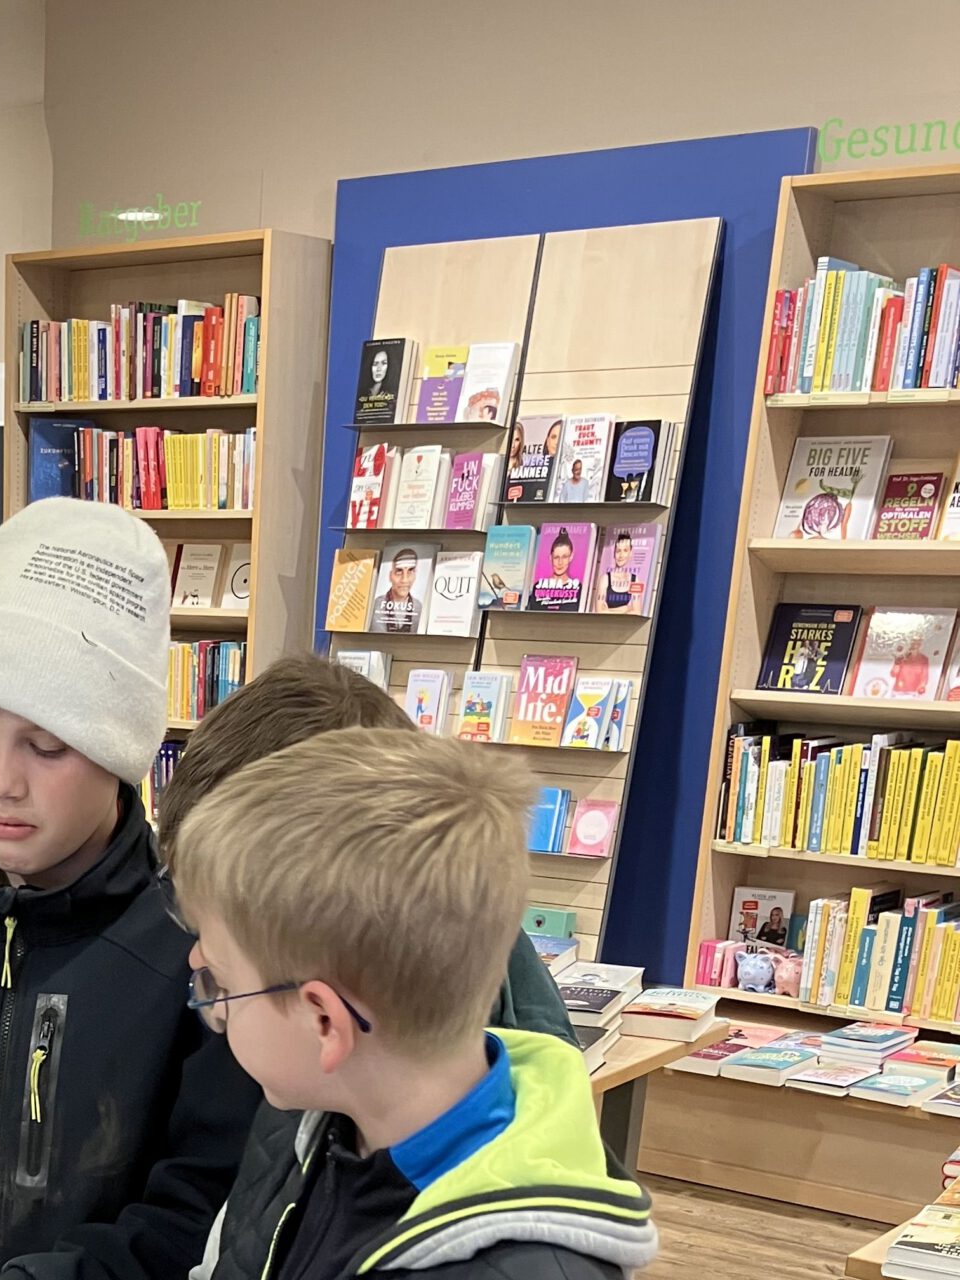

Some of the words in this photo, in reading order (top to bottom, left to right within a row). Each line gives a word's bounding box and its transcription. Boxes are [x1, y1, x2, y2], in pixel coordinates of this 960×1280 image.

[817, 116, 960, 163] Gesun
[522, 444, 543, 455] ALTE
[523, 455, 550, 467] WEISE
[806, 448, 833, 466] BIG
[835, 447, 872, 466] FIVE
[808, 467, 826, 477] FOR
[827, 466, 861, 477] HEALTH
[451, 474, 480, 492] FUCK
[906, 483, 918, 497] 9
[883, 496, 934, 508] REGELN
[880, 511, 932, 520] OPTIMALEN
[878, 520, 930, 532] STOFF
[434, 576, 477, 601] QUIT
[379, 600, 415, 611] FOKUS.
[790, 628, 834, 641] STARKES
[520, 665, 571, 696] Mid
[516, 693, 563, 724] life.
